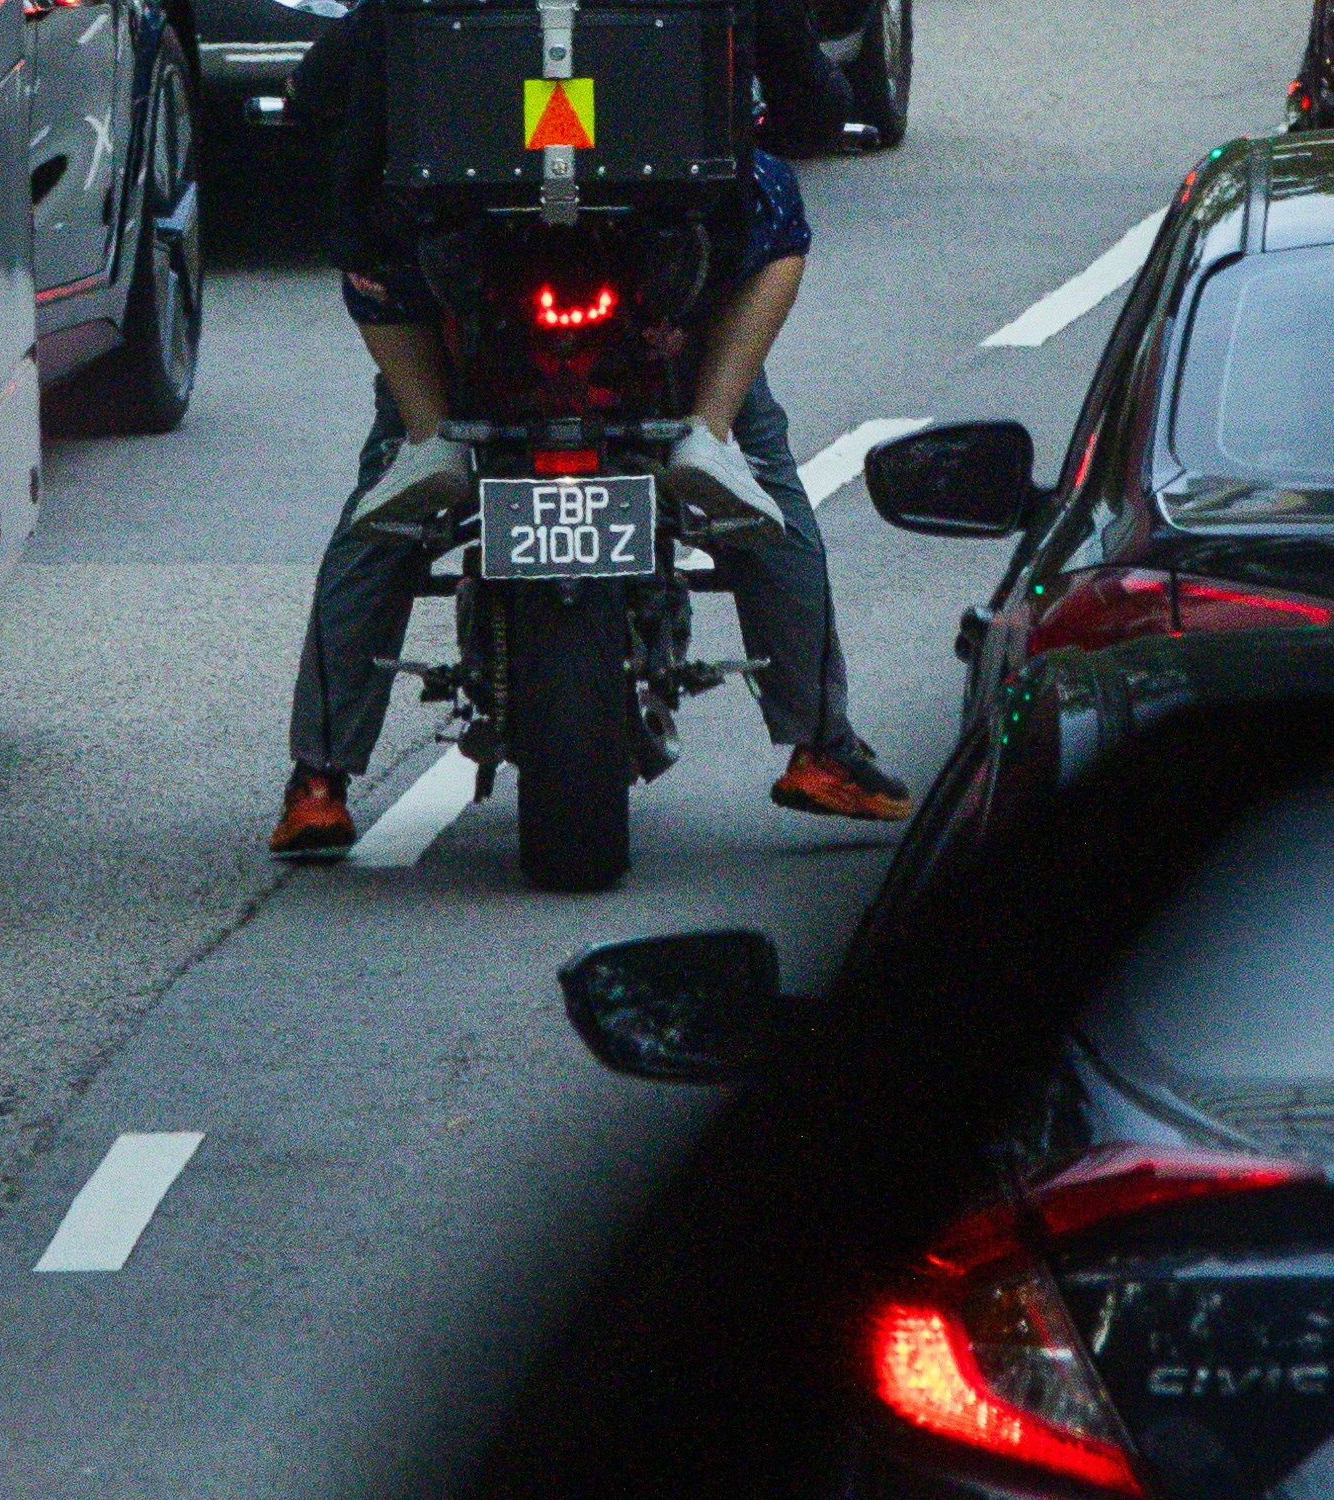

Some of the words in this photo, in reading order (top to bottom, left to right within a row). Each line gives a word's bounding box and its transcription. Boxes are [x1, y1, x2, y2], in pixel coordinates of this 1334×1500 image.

[533, 486, 609, 524] FBP
[510, 525, 600, 564] 2100
[609, 523, 636, 563] Z
